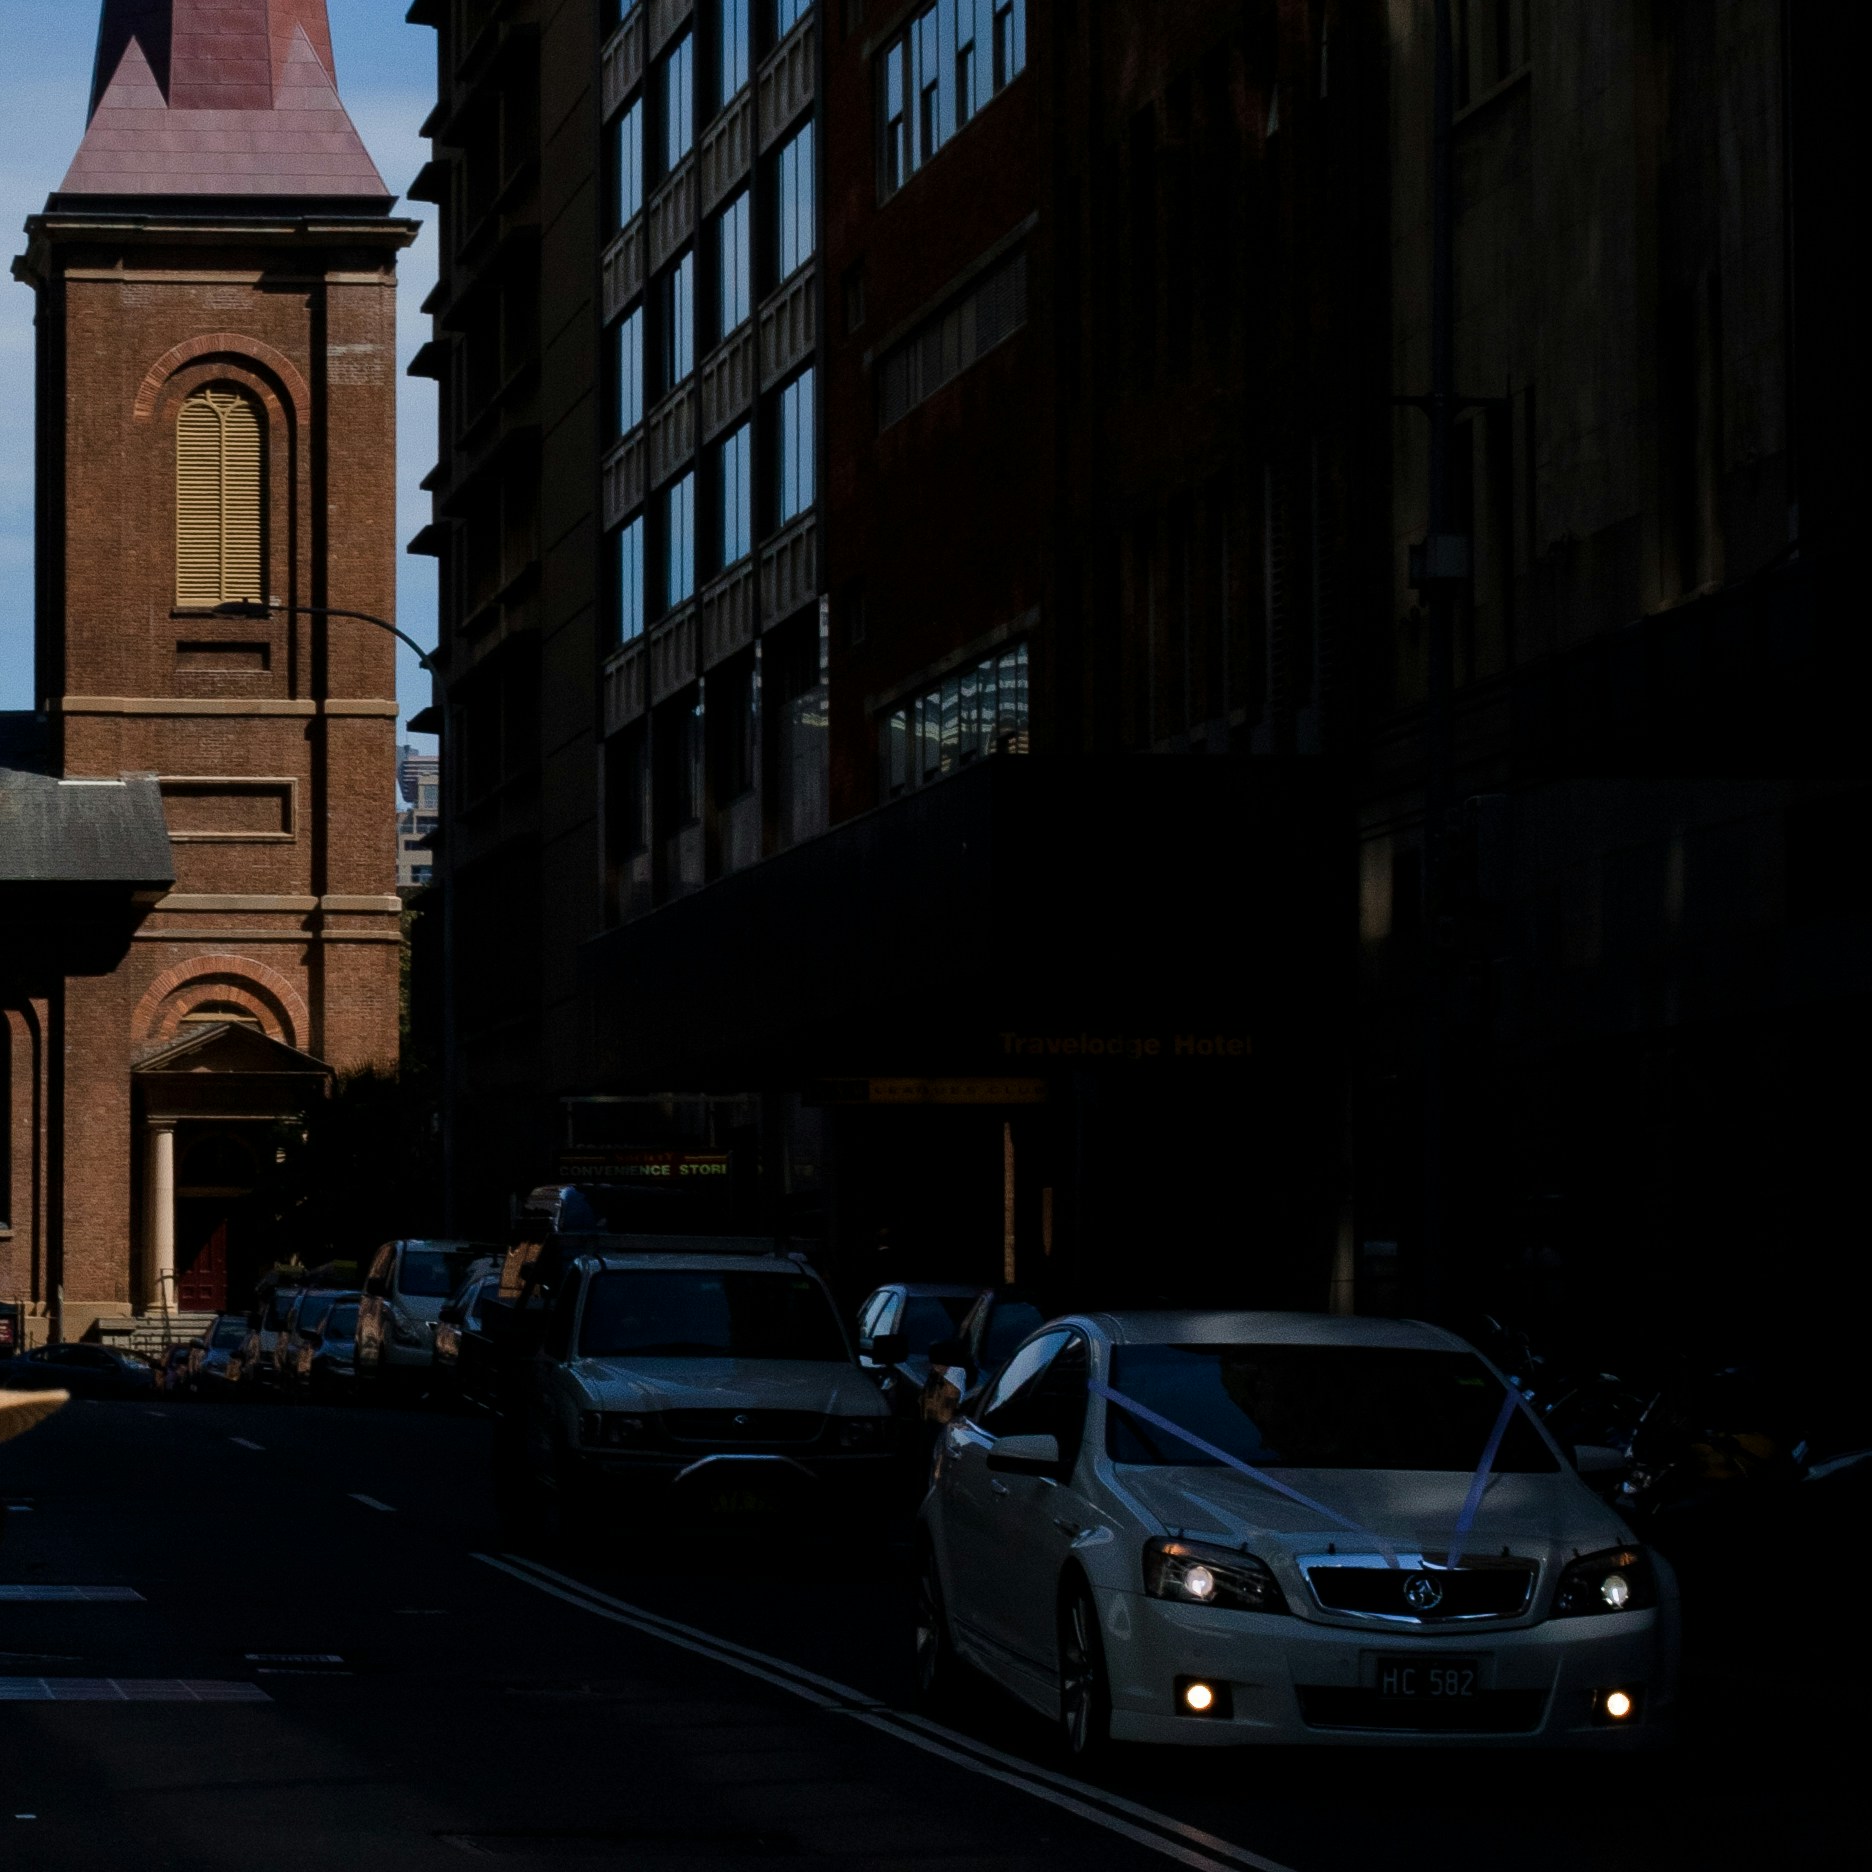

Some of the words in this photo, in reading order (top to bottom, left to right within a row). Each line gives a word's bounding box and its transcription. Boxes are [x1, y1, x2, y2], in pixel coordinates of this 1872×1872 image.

[997, 1030, 1162, 1065] Travelodge
[1174, 1030, 1253, 1056] Hotel
[559, 1163, 672, 1177] CONVENIENCE
[1382, 1666, 1417, 1695] HC
[1429, 1668, 1475, 1697] 582
